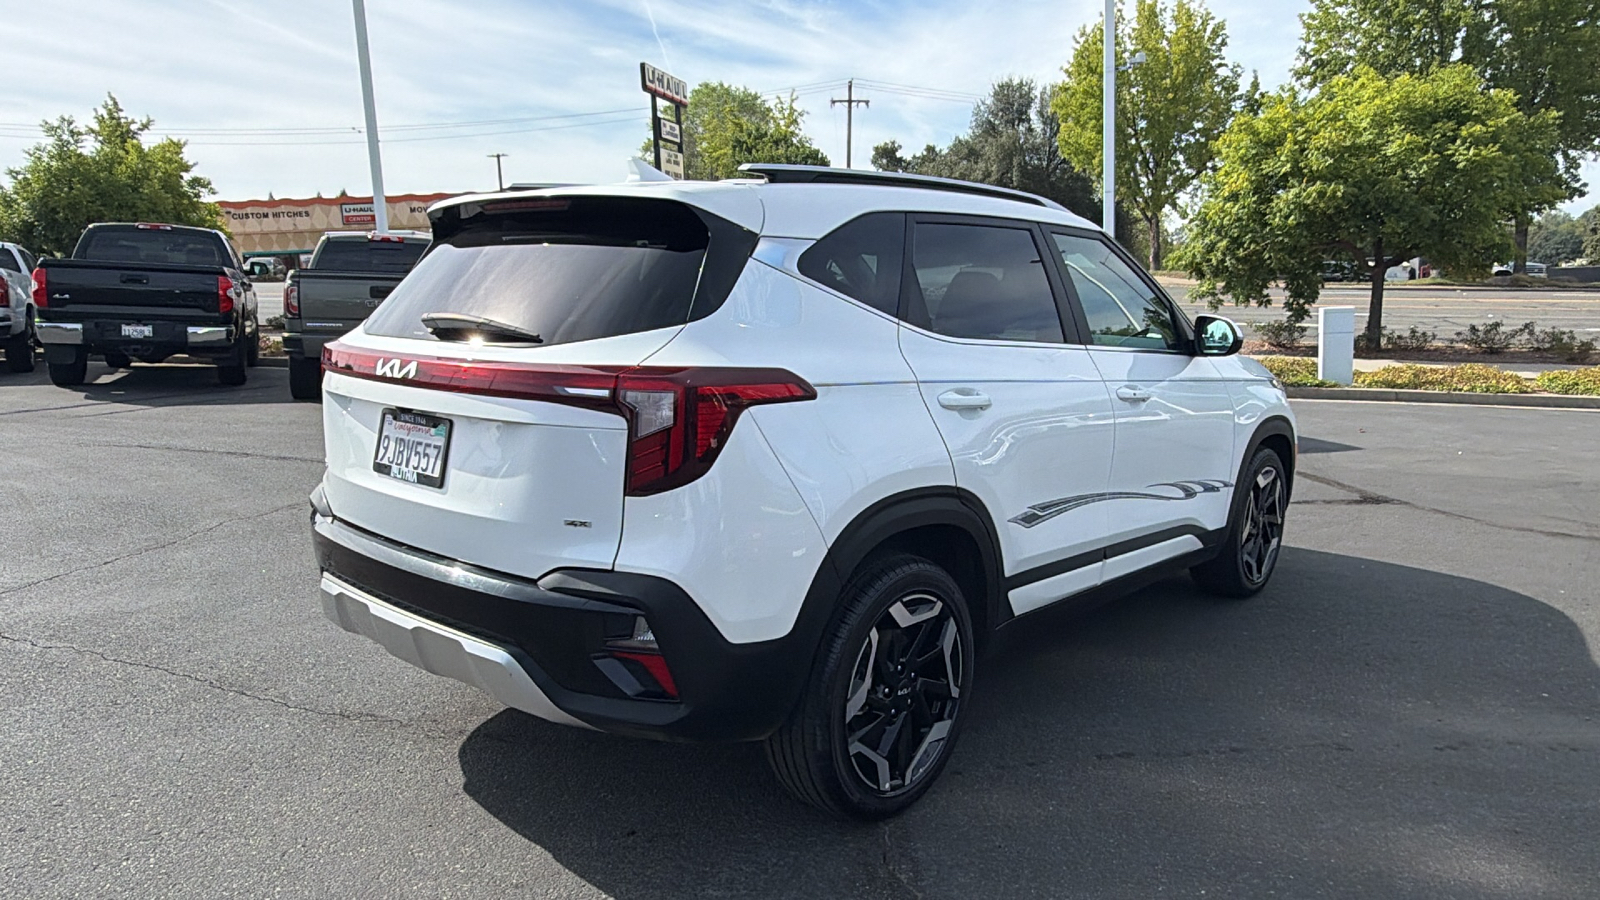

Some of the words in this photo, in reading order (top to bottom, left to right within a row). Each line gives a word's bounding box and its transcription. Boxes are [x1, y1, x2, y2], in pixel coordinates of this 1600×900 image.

[232, 212, 269, 220] CUSTOM
[272, 211, 310, 219] HITCHES
[376, 358, 418, 378] KIA
[400, 414, 415, 423] SINCE
[380, 435, 442, 474] 9JBV557
